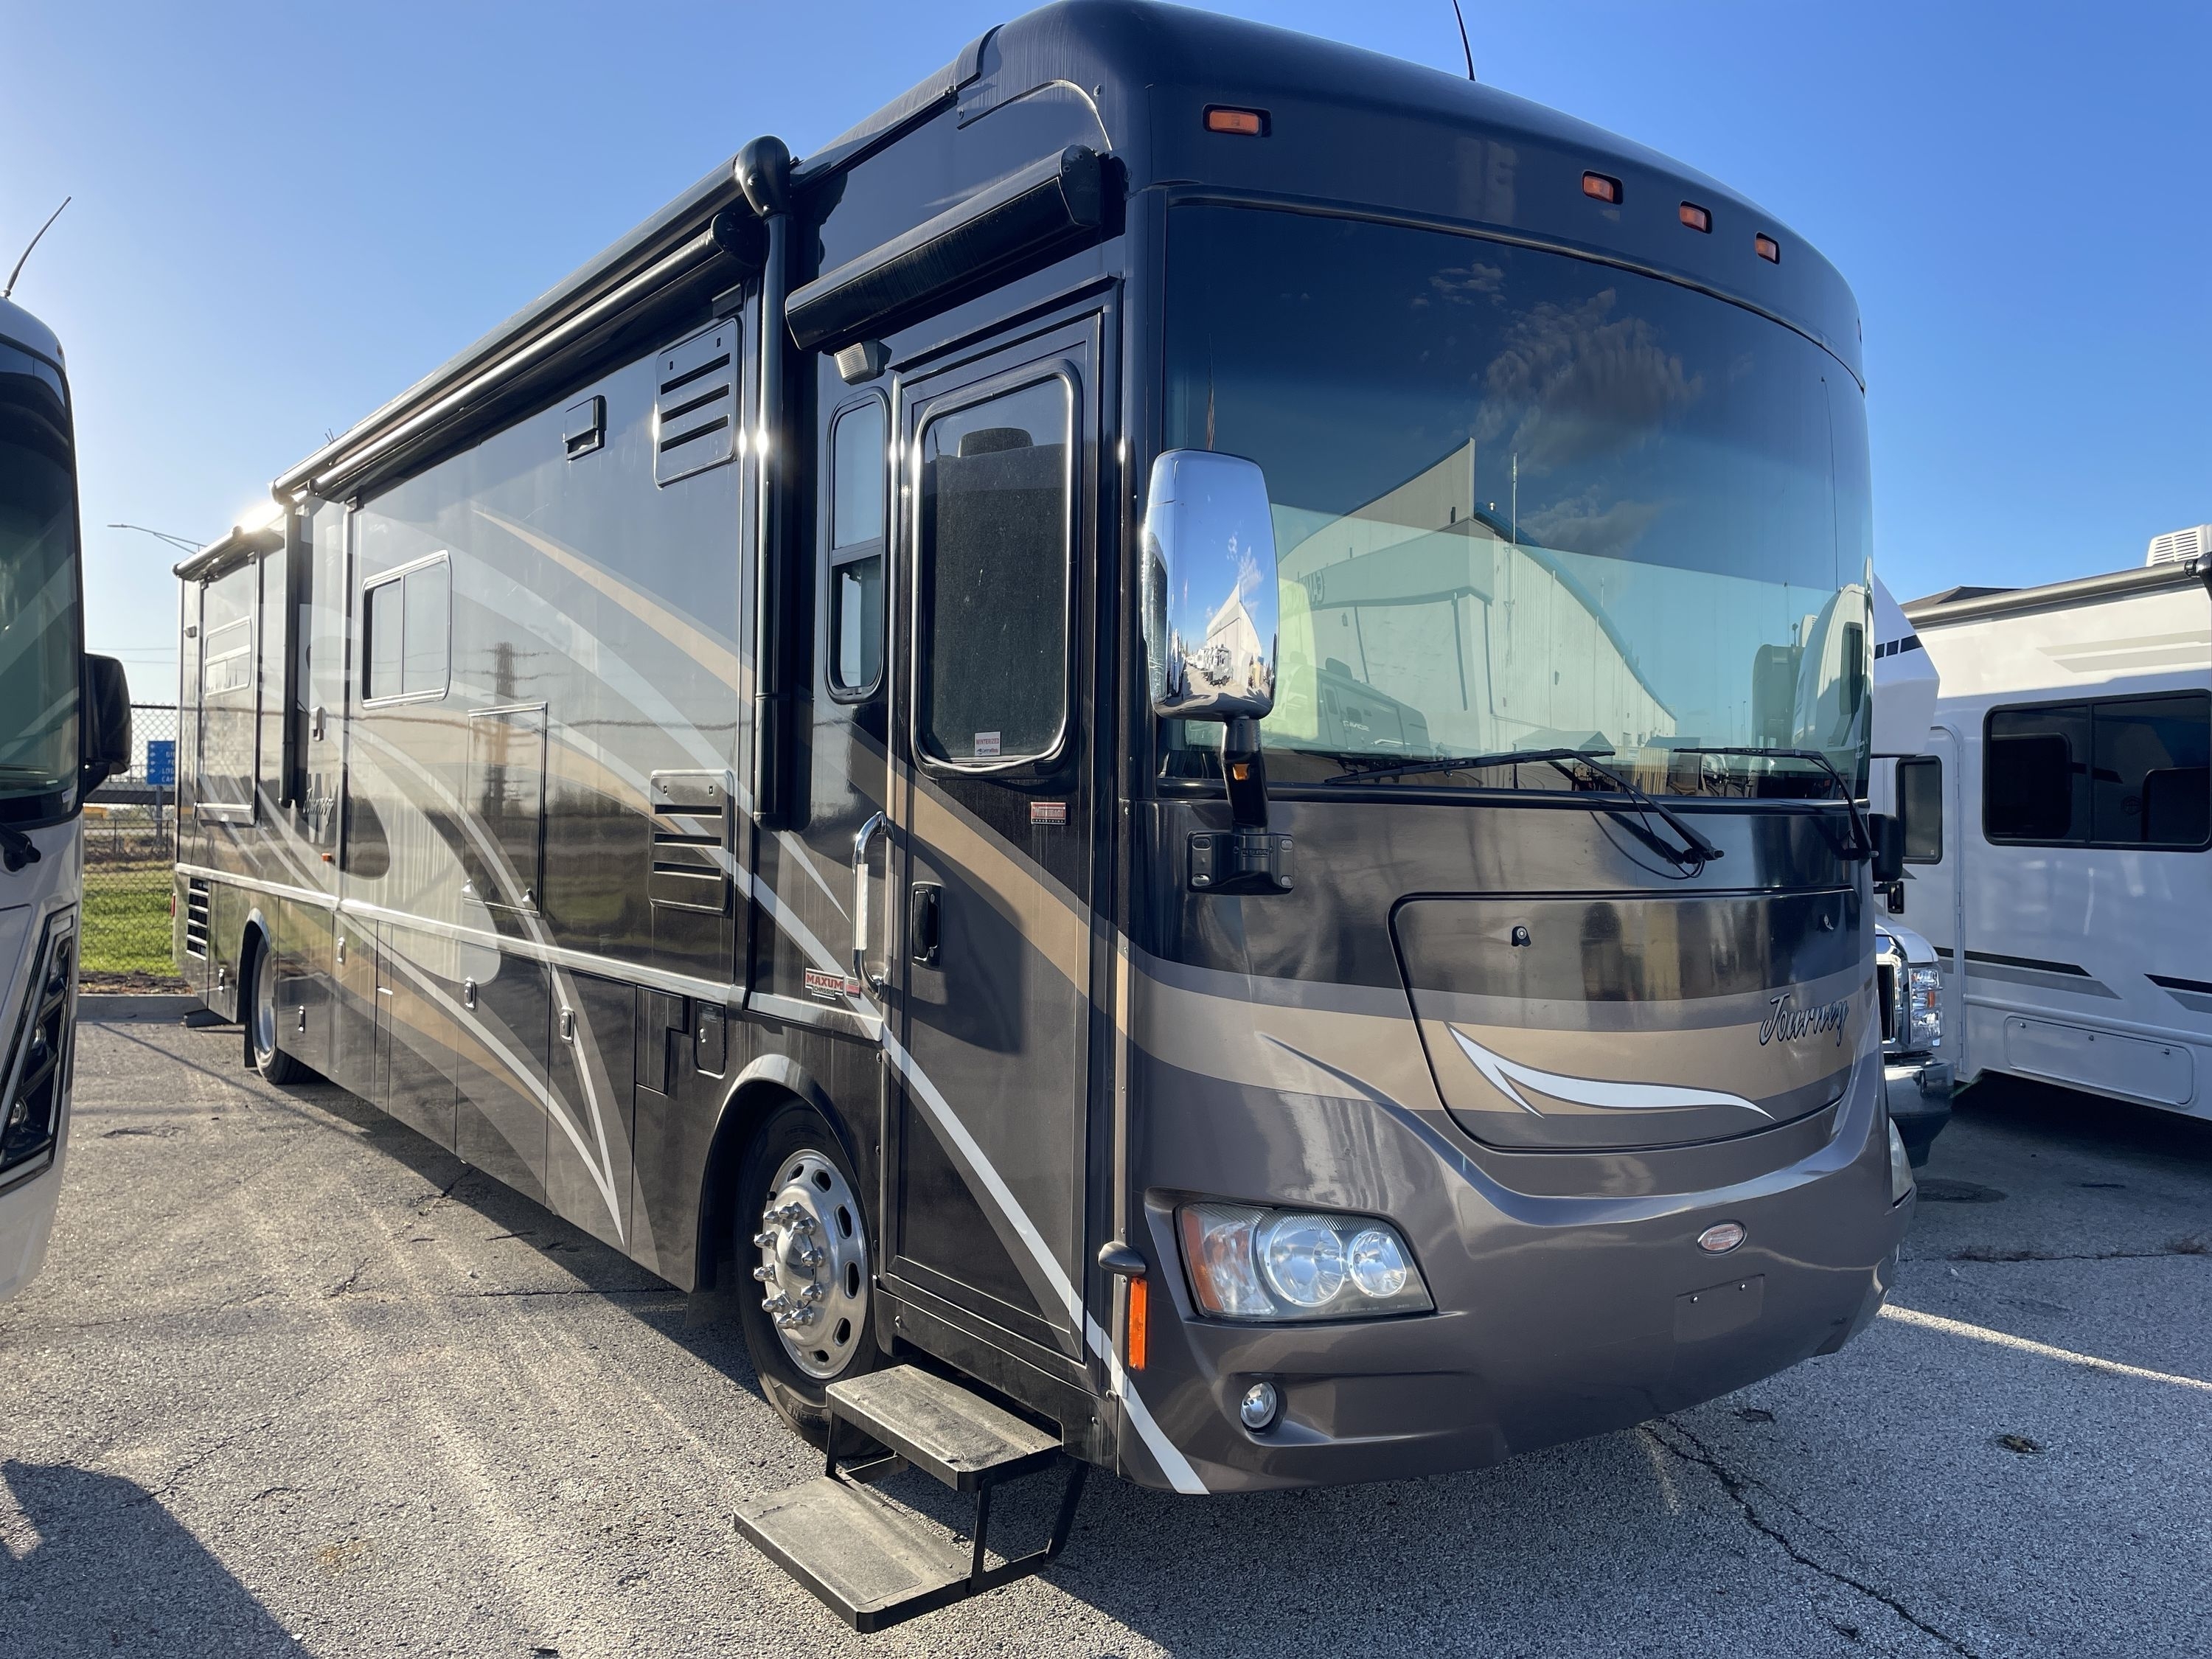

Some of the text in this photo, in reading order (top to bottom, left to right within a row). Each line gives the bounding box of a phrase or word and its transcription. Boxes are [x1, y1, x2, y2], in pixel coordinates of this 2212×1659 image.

[806, 974, 844, 990] MAXUM
[813, 987, 835, 995] CHASSIS
[1759, 991, 1849, 1047] Journey
